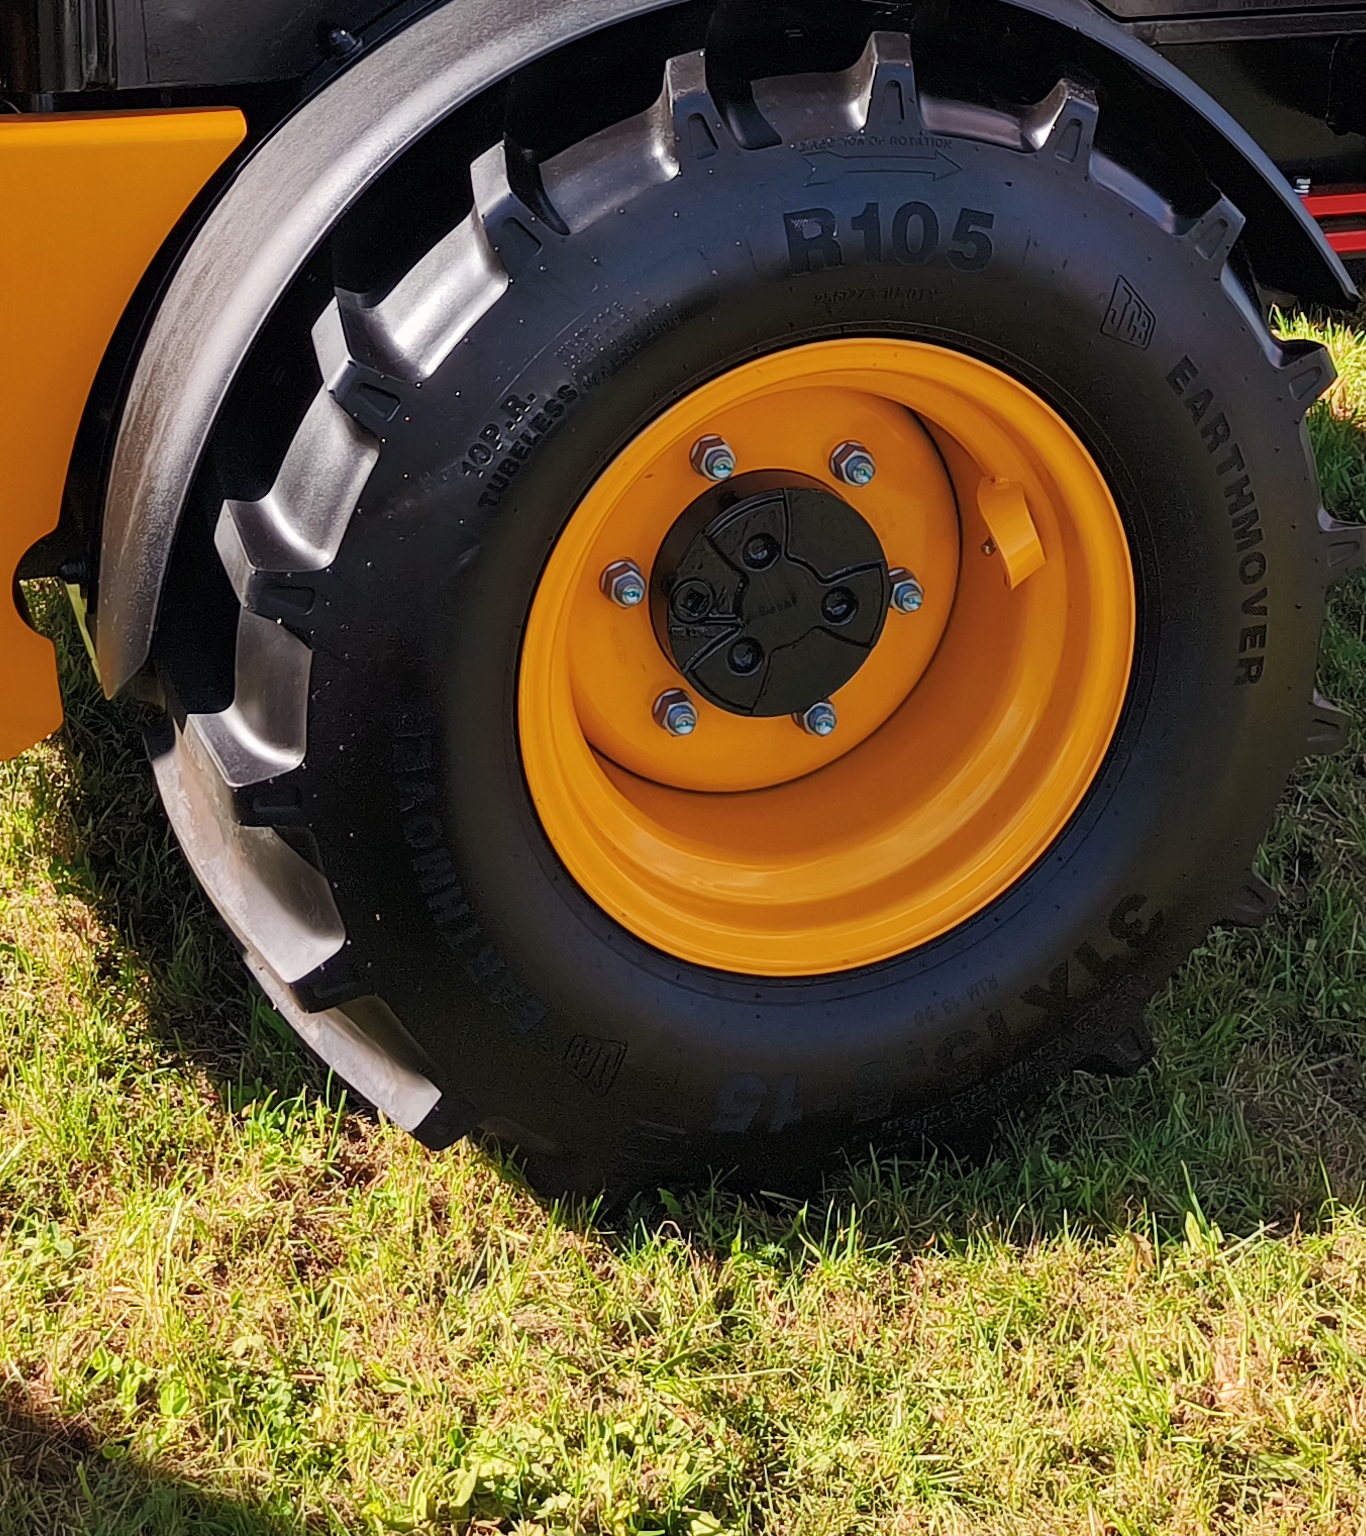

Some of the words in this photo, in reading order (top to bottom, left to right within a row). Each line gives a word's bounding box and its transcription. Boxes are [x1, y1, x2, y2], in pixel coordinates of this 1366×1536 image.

[889, 135, 954, 150] ROTATION
[782, 200, 996, 276] R105
[477, 383, 580, 509] TUBELESS
[1166, 355, 1268, 686] EARTHMOVER
